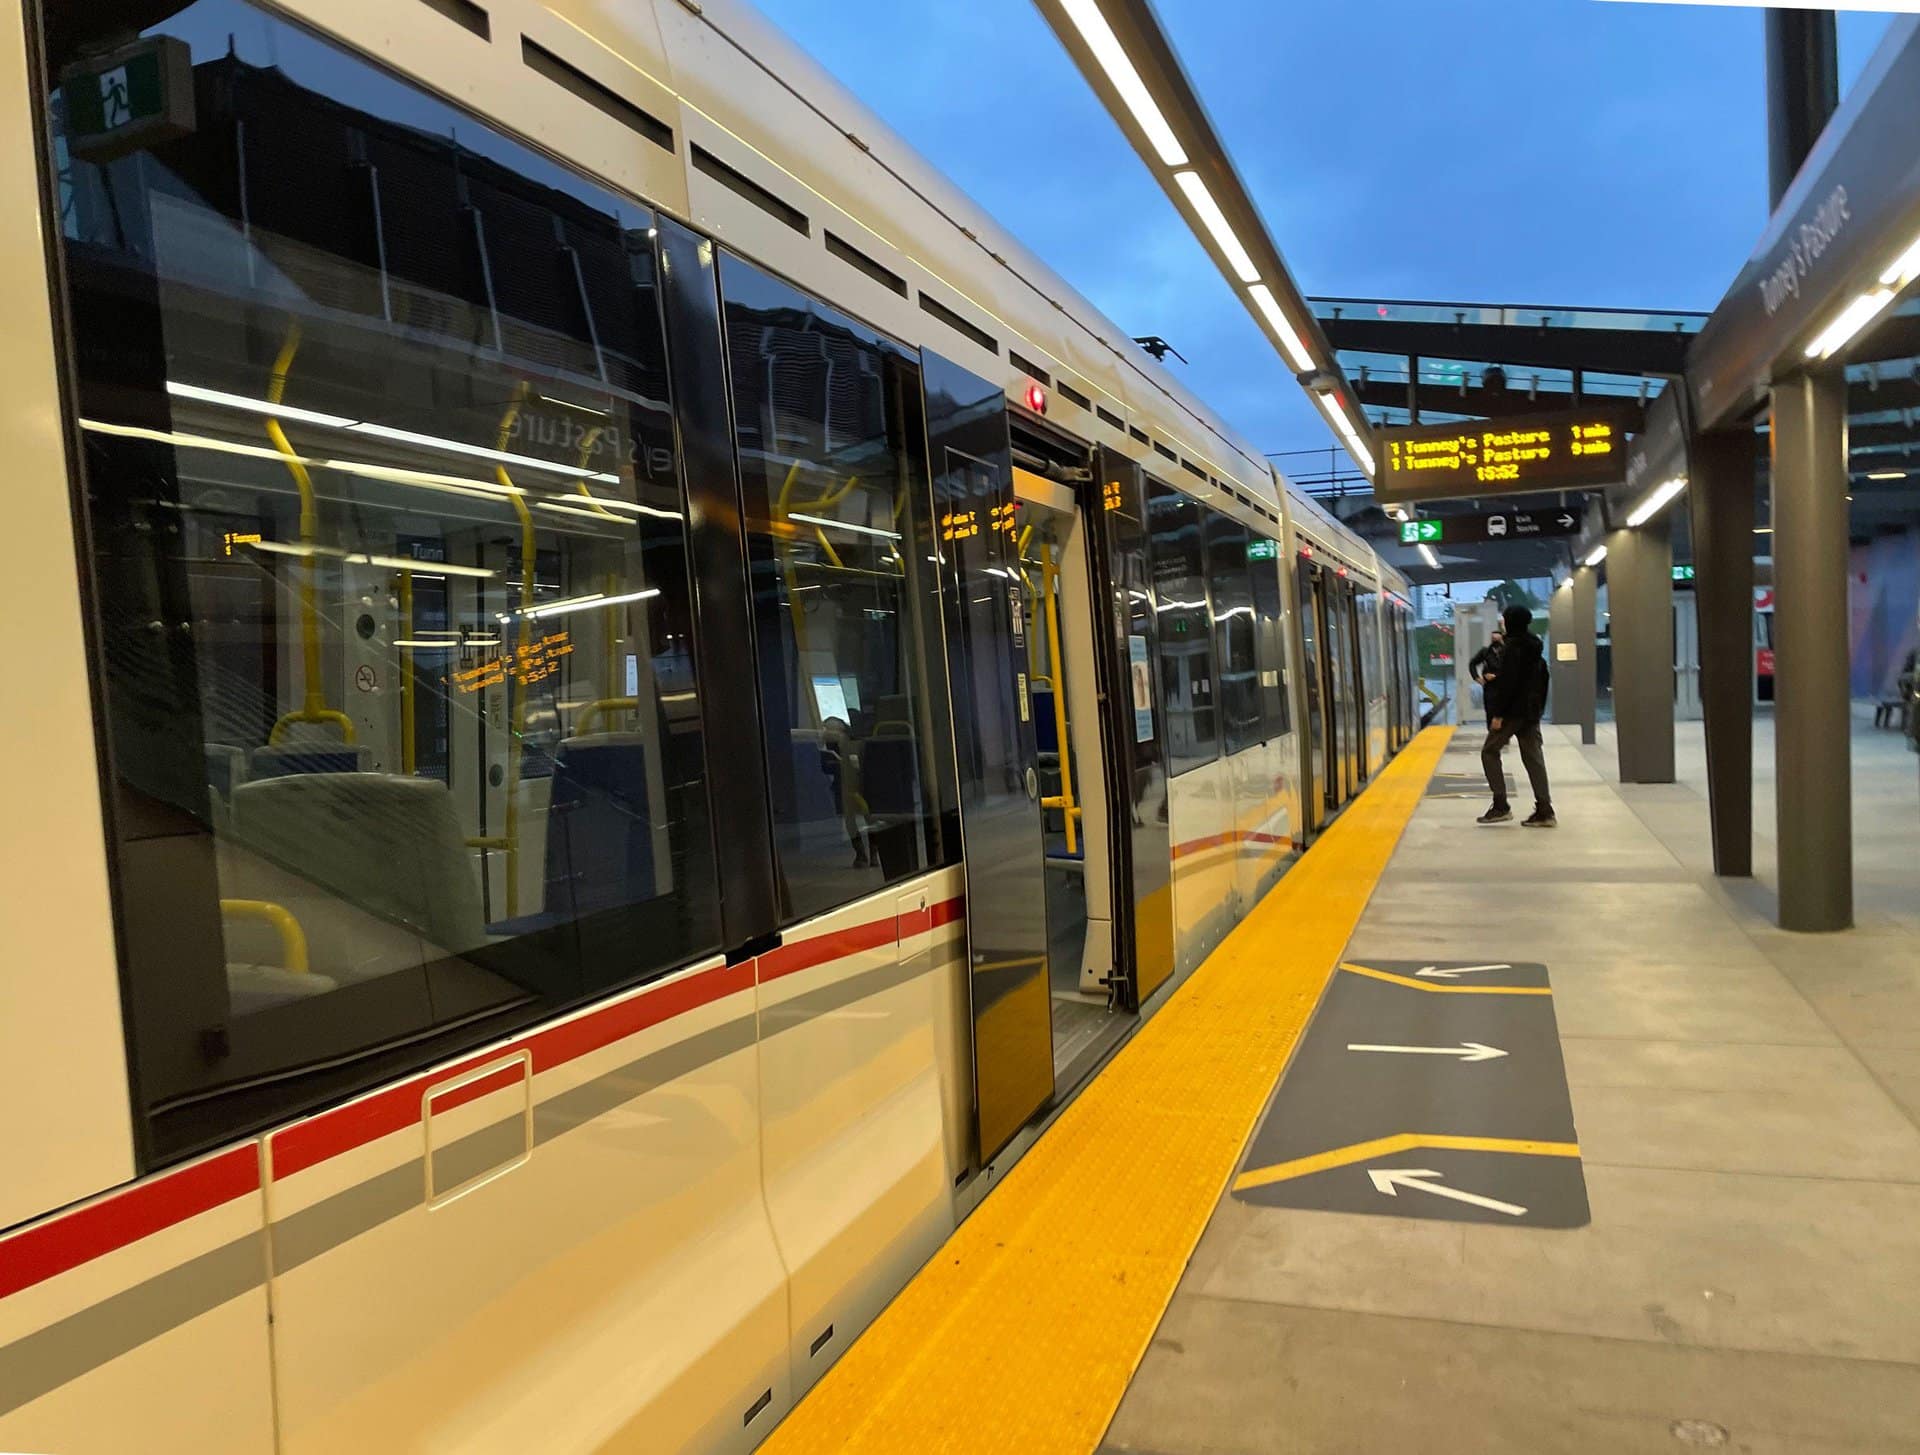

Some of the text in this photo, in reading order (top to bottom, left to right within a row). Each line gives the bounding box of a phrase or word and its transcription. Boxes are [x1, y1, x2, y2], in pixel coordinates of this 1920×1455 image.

[1404, 435, 1478, 454] Tunney's
[1482, 431, 1550, 447] Pasture
[1404, 451, 1477, 471] Tunney's
[1482, 447, 1550, 463] Pasture
